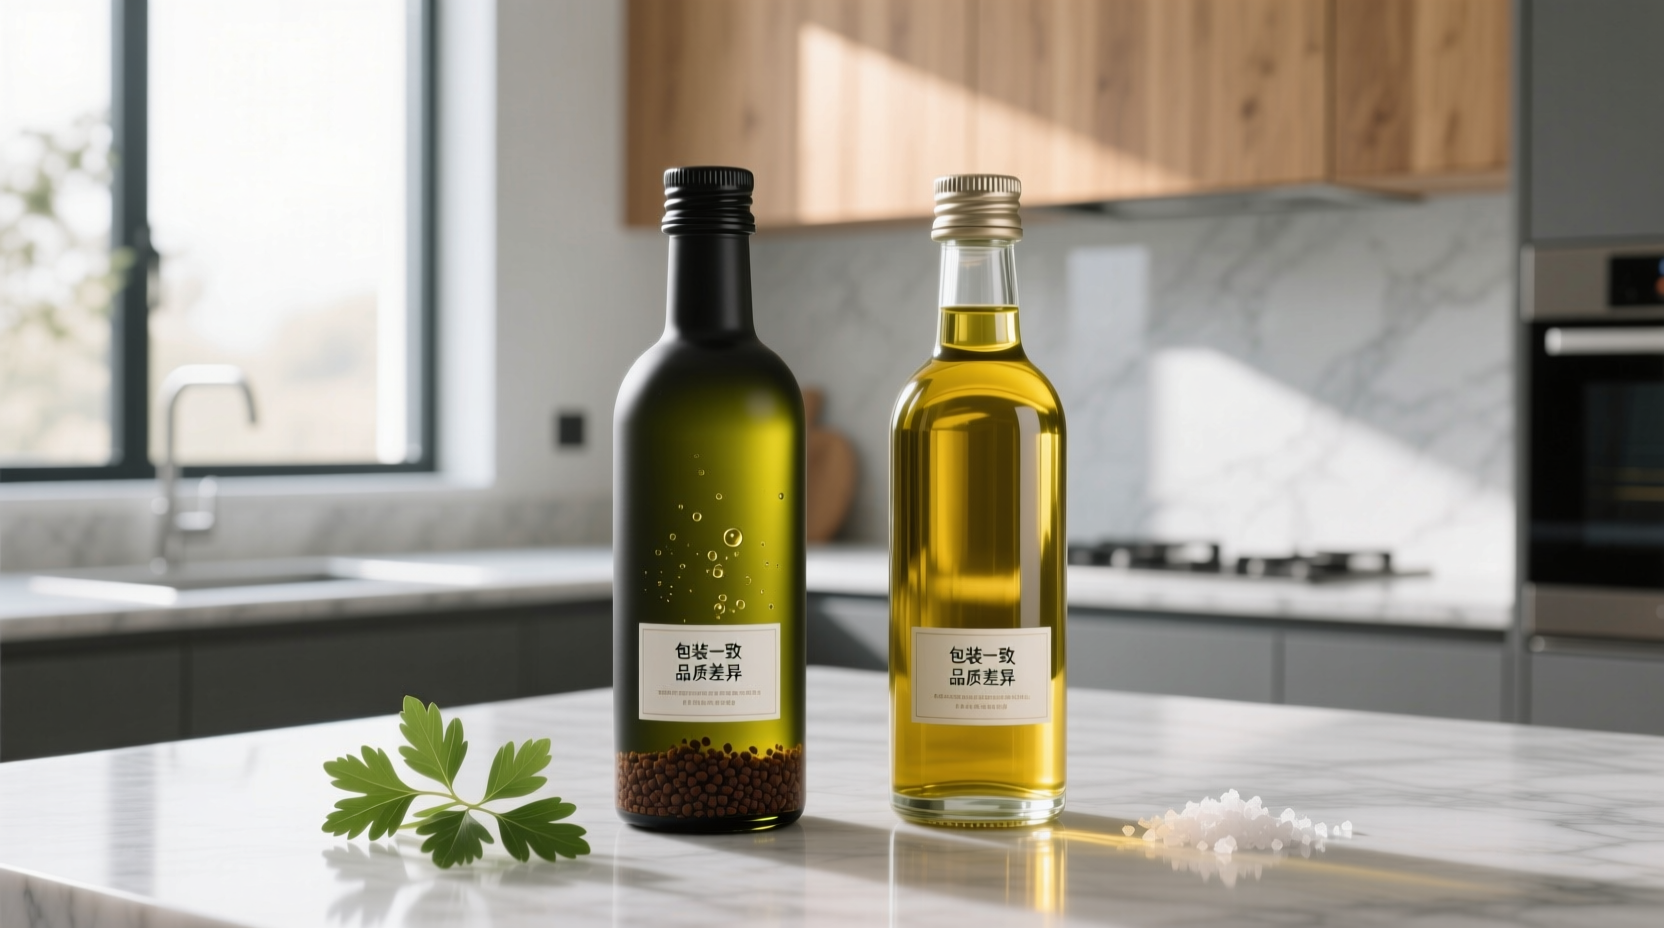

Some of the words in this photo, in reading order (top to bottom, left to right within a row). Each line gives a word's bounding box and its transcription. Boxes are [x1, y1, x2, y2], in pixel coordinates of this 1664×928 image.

[675, 642, 742, 660] 包装一致
[949, 646, 1016, 665] 包装一致
[675, 663, 742, 682] 品质差异
[949, 668, 1016, 687] 品质差异
